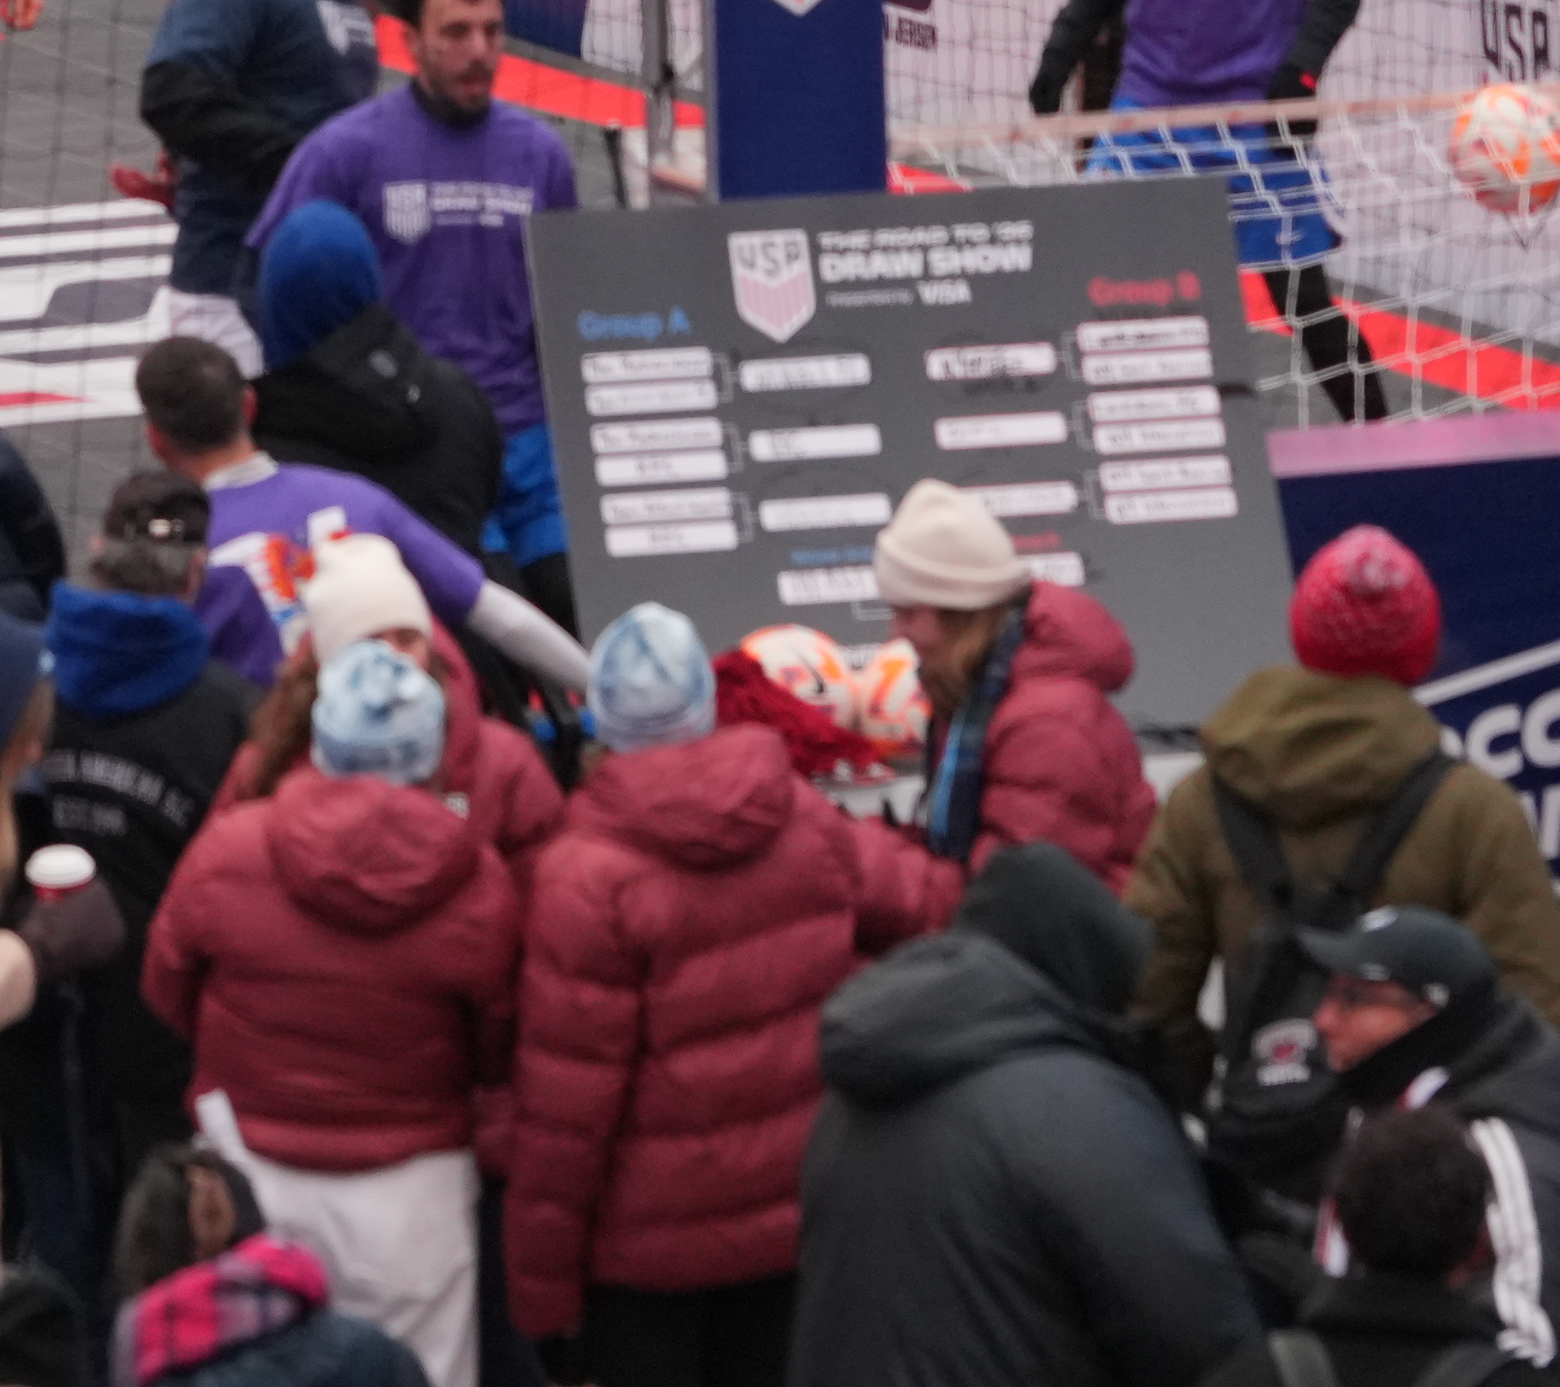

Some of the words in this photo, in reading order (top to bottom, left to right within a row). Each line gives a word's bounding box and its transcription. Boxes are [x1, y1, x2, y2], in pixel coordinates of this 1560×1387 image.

[735, 231, 801, 275] USA
[817, 250, 923, 283] DRAW
[925, 243, 1034, 276] SHOW
[916, 278, 973, 305] VISA
[577, 308, 665, 342] Group
[668, 308, 692, 335] A
